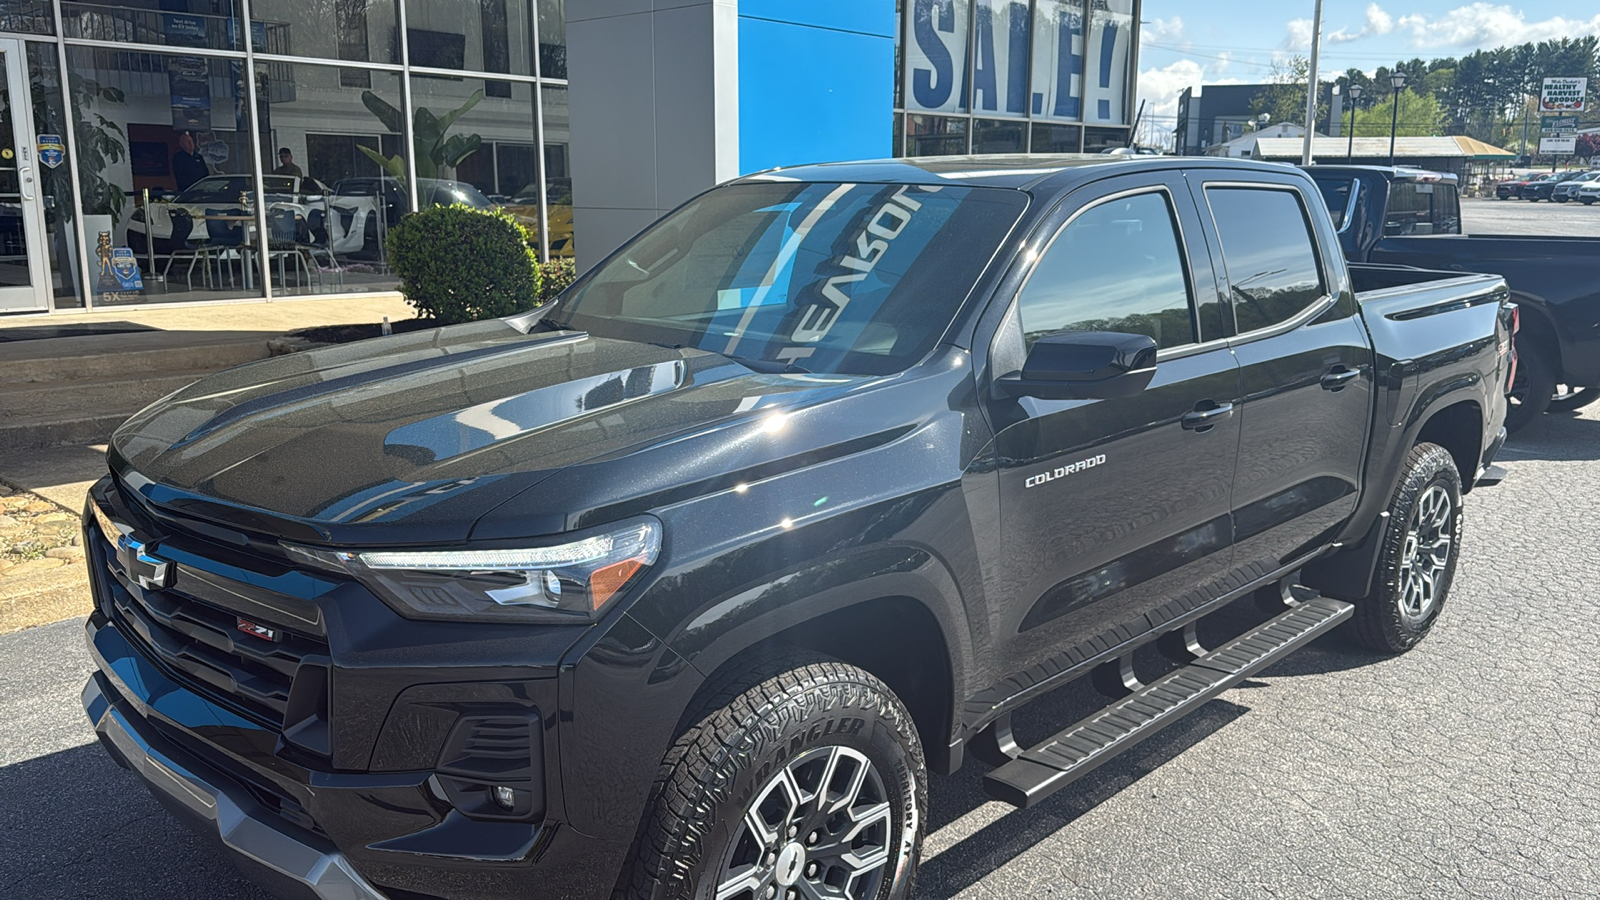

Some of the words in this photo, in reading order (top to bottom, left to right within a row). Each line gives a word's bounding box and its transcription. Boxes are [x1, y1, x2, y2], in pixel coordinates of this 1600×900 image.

[912, 0, 1118, 119] SALE!
[103, 291, 121, 302] 5X
[1025, 453, 1106, 488] COLORADO
[238, 619, 273, 638] Z71
